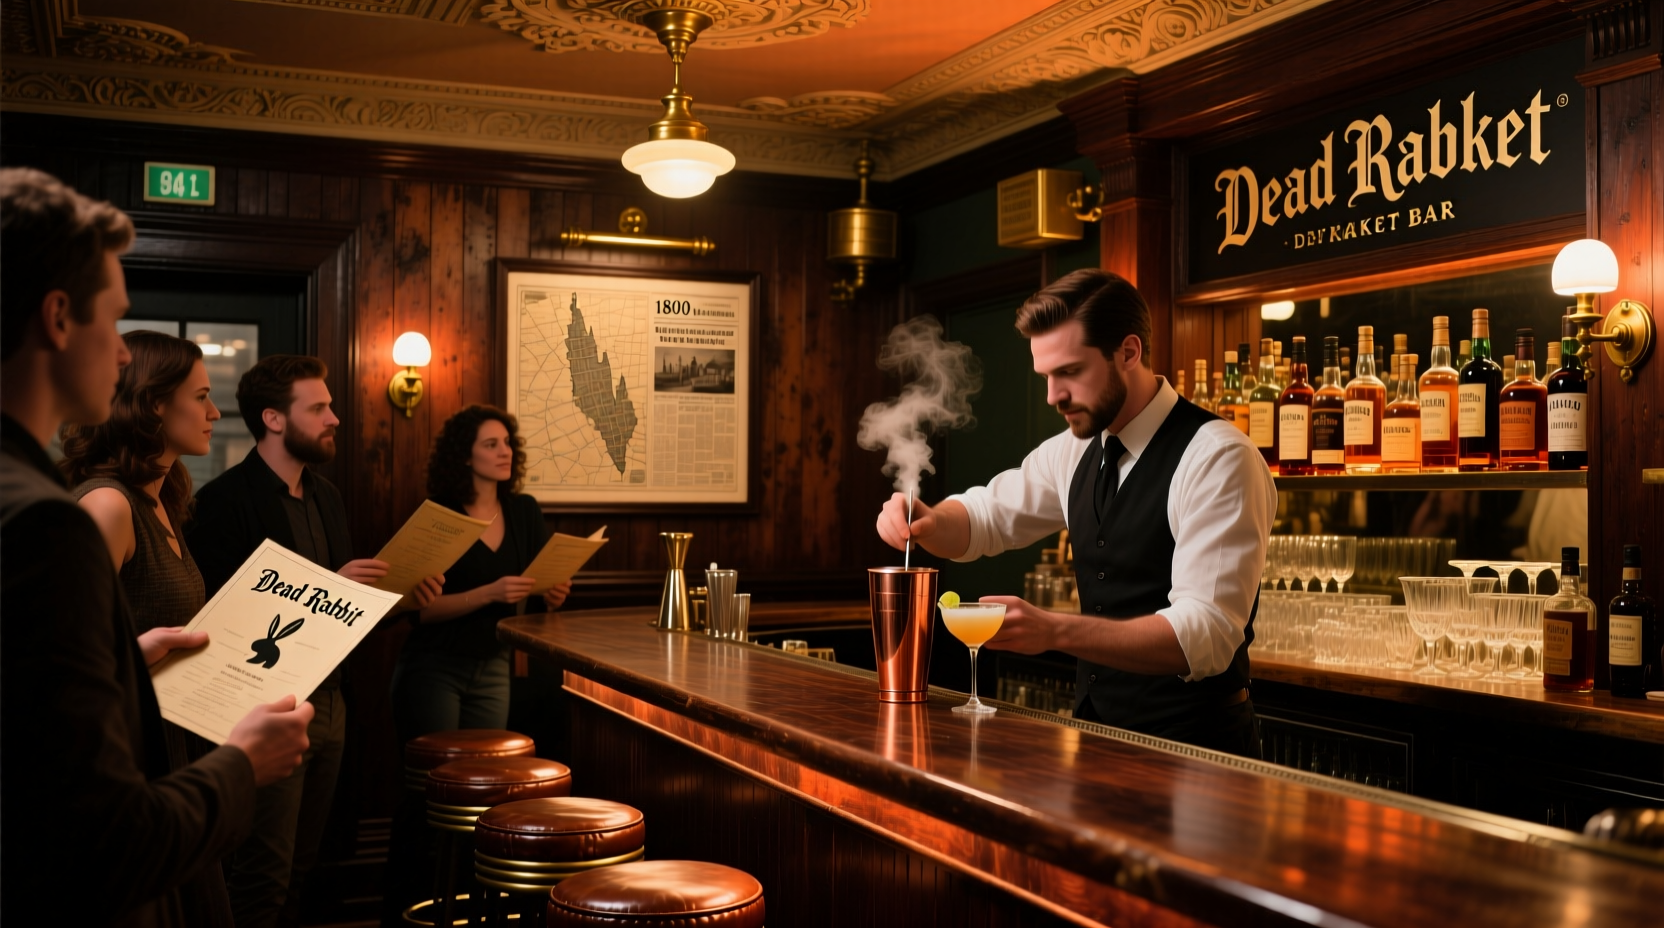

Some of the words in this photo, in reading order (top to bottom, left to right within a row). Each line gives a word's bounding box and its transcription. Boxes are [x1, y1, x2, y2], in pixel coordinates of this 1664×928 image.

[1214, 130, 1337, 255] Dead
[1344, 88, 1552, 208] Rabket
[1408, 200, 1456, 228] BAR
[655, 299, 691, 316] 1800
[250, 568, 310, 603] Dead
[303, 587, 365, 627] Rabbit
